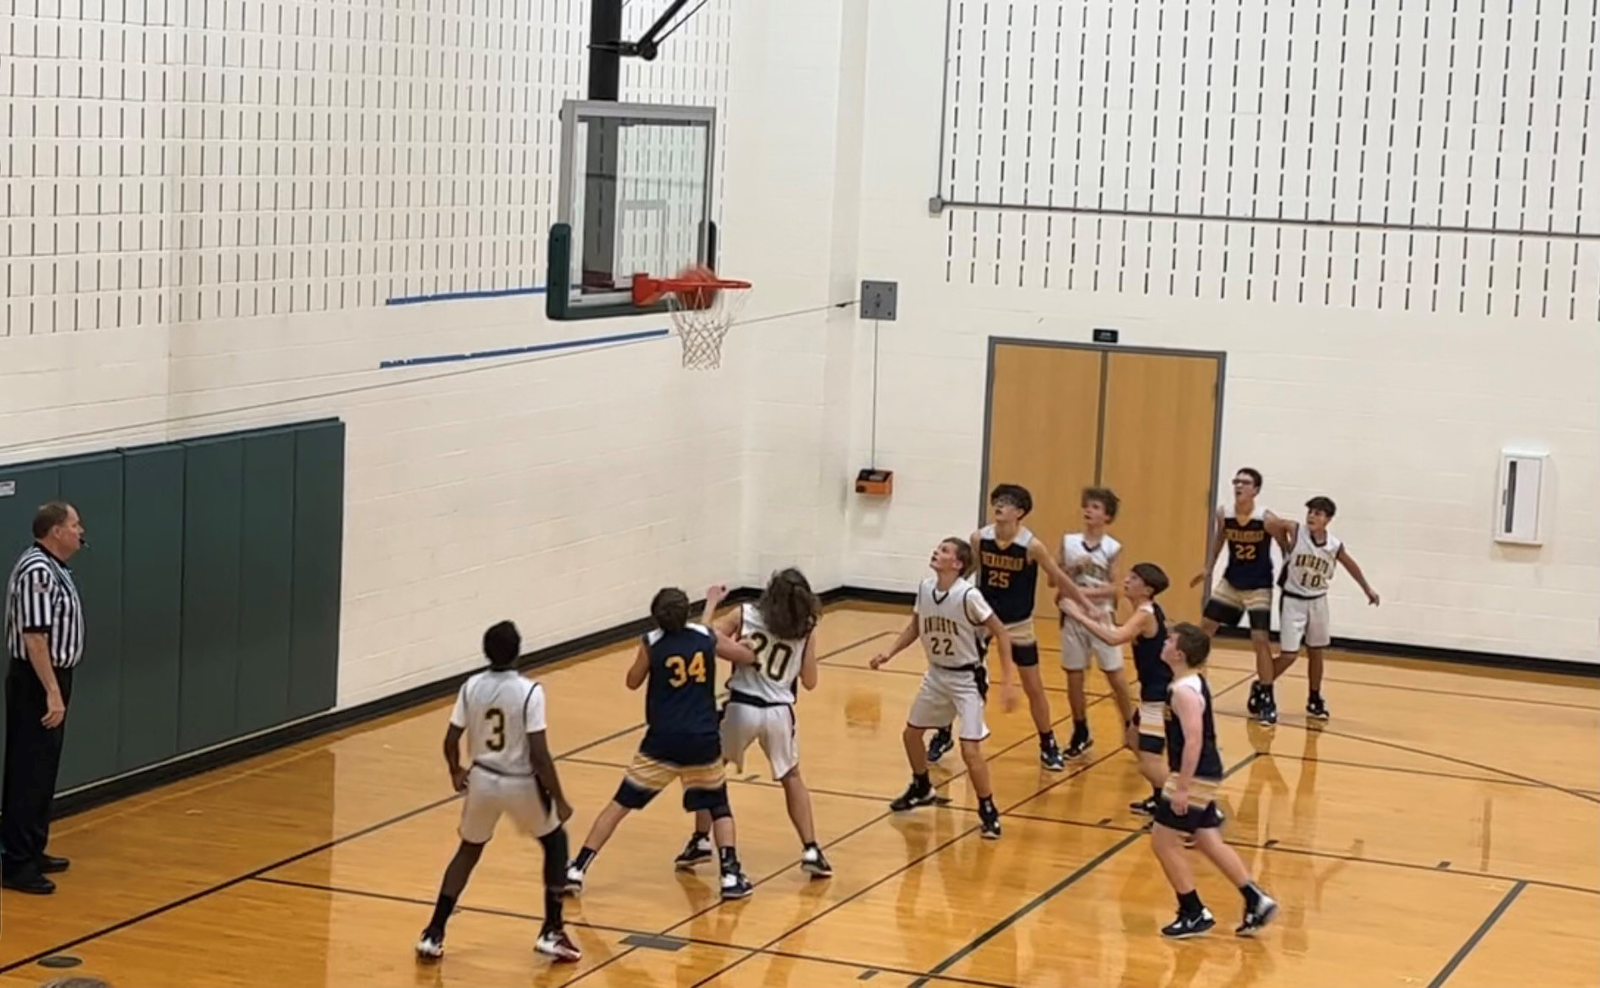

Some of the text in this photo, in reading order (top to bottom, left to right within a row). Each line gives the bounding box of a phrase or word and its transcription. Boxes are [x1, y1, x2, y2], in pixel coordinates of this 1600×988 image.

[1235, 544, 1256, 560] 22
[988, 570, 1010, 589] 25
[1300, 572, 1321, 588] 10
[930, 637, 955, 656] 22
[665, 651, 707, 688] 34
[484, 708, 505, 752] 3
